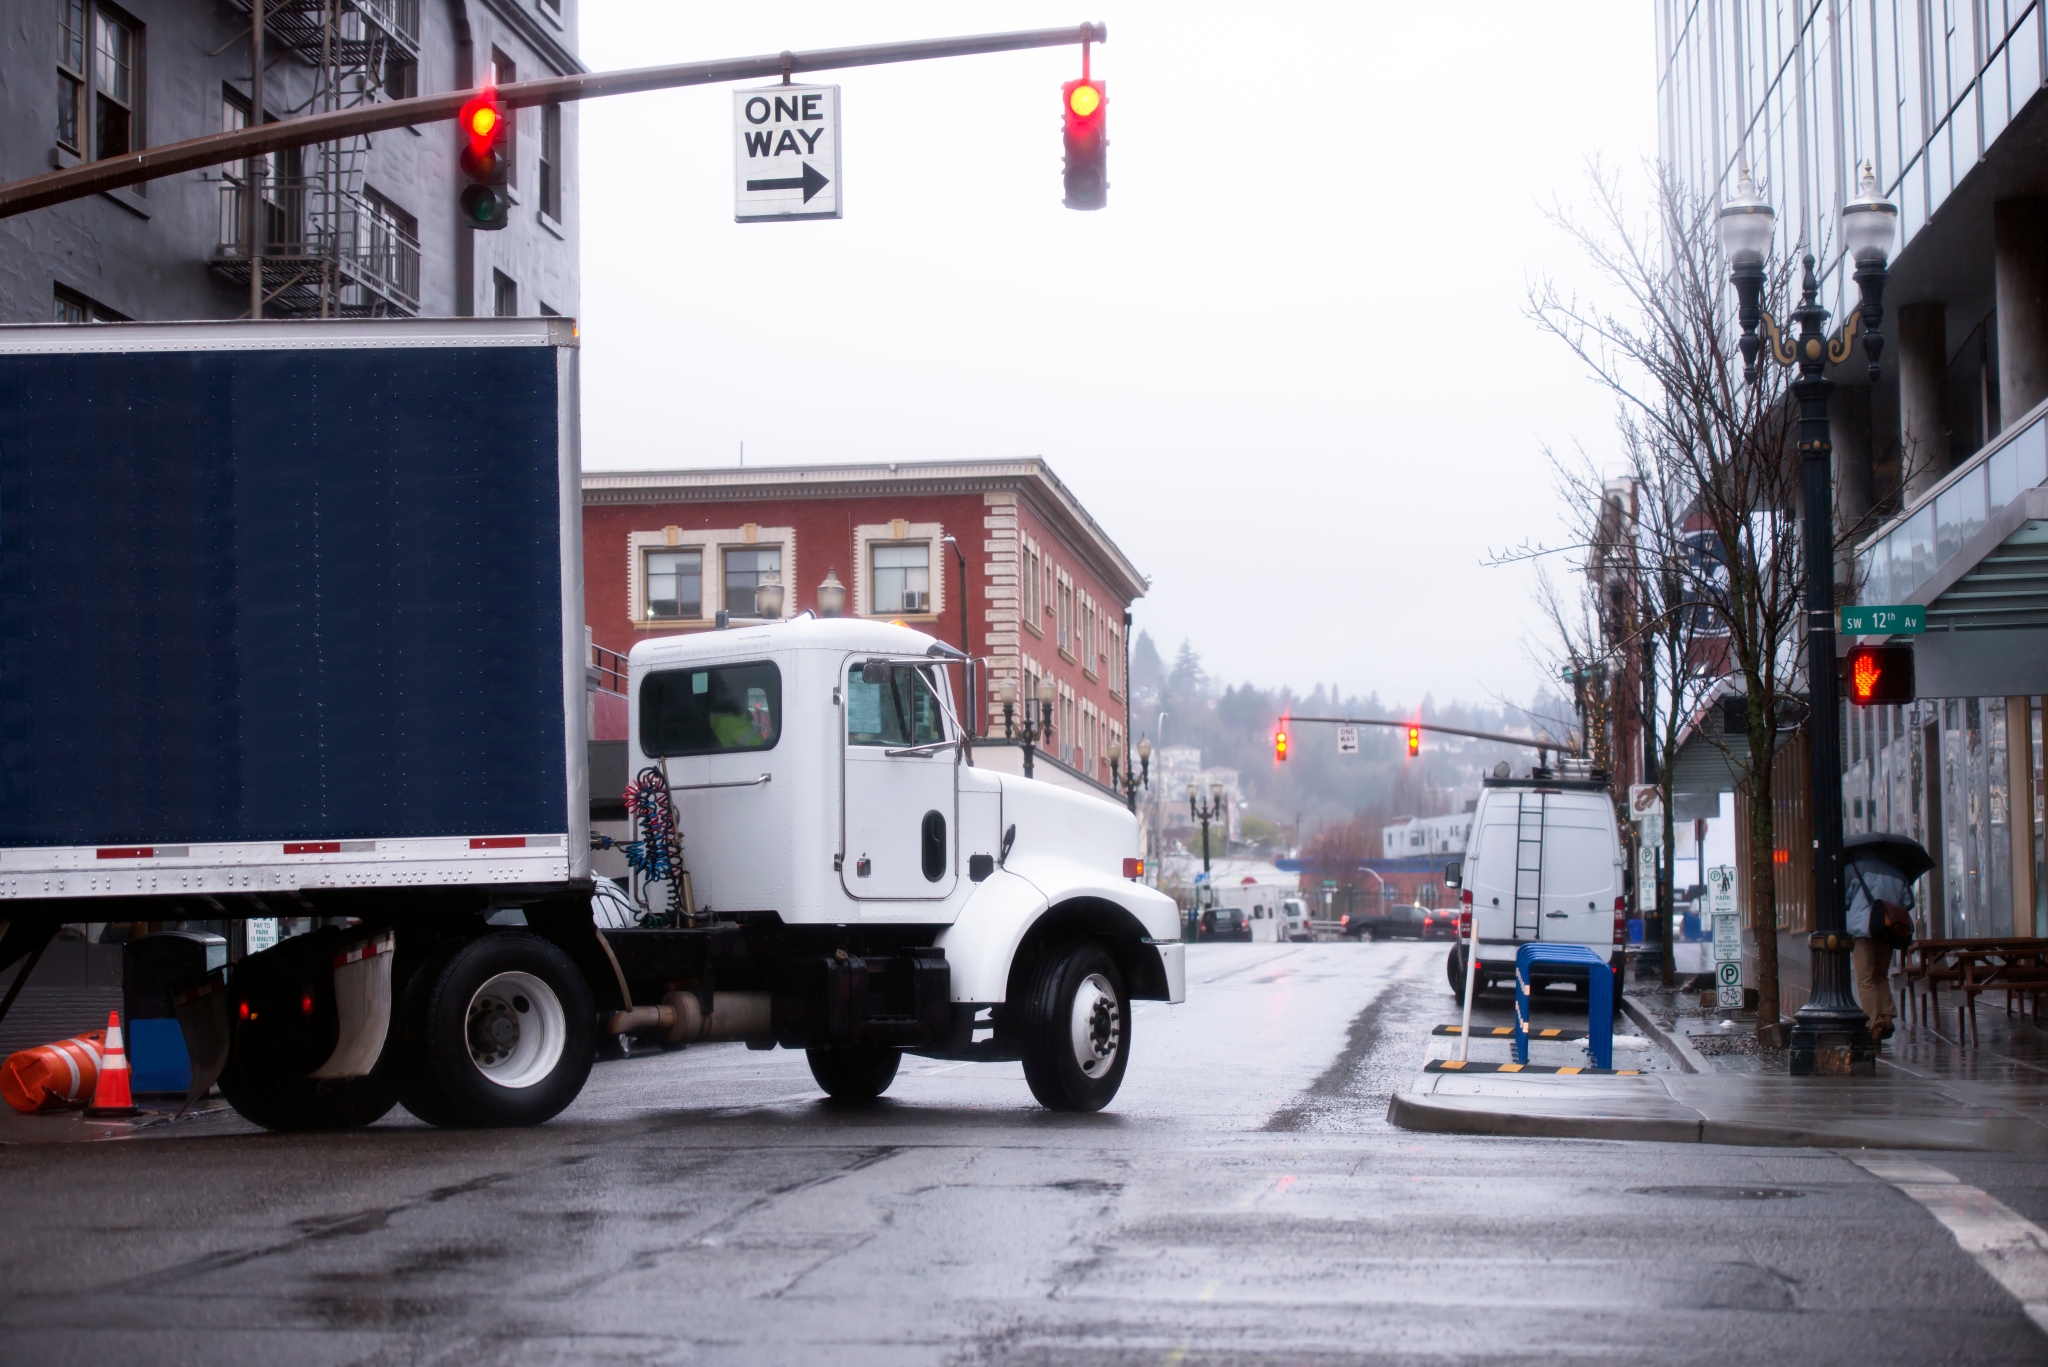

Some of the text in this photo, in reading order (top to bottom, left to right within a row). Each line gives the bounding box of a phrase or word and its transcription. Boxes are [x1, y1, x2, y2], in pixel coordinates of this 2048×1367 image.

[745, 94, 823, 124] ONE
[744, 127, 825, 158] WAY
[1847, 612, 1917, 629] SW 12th Av
[1726, 968, 1734, 981] P
